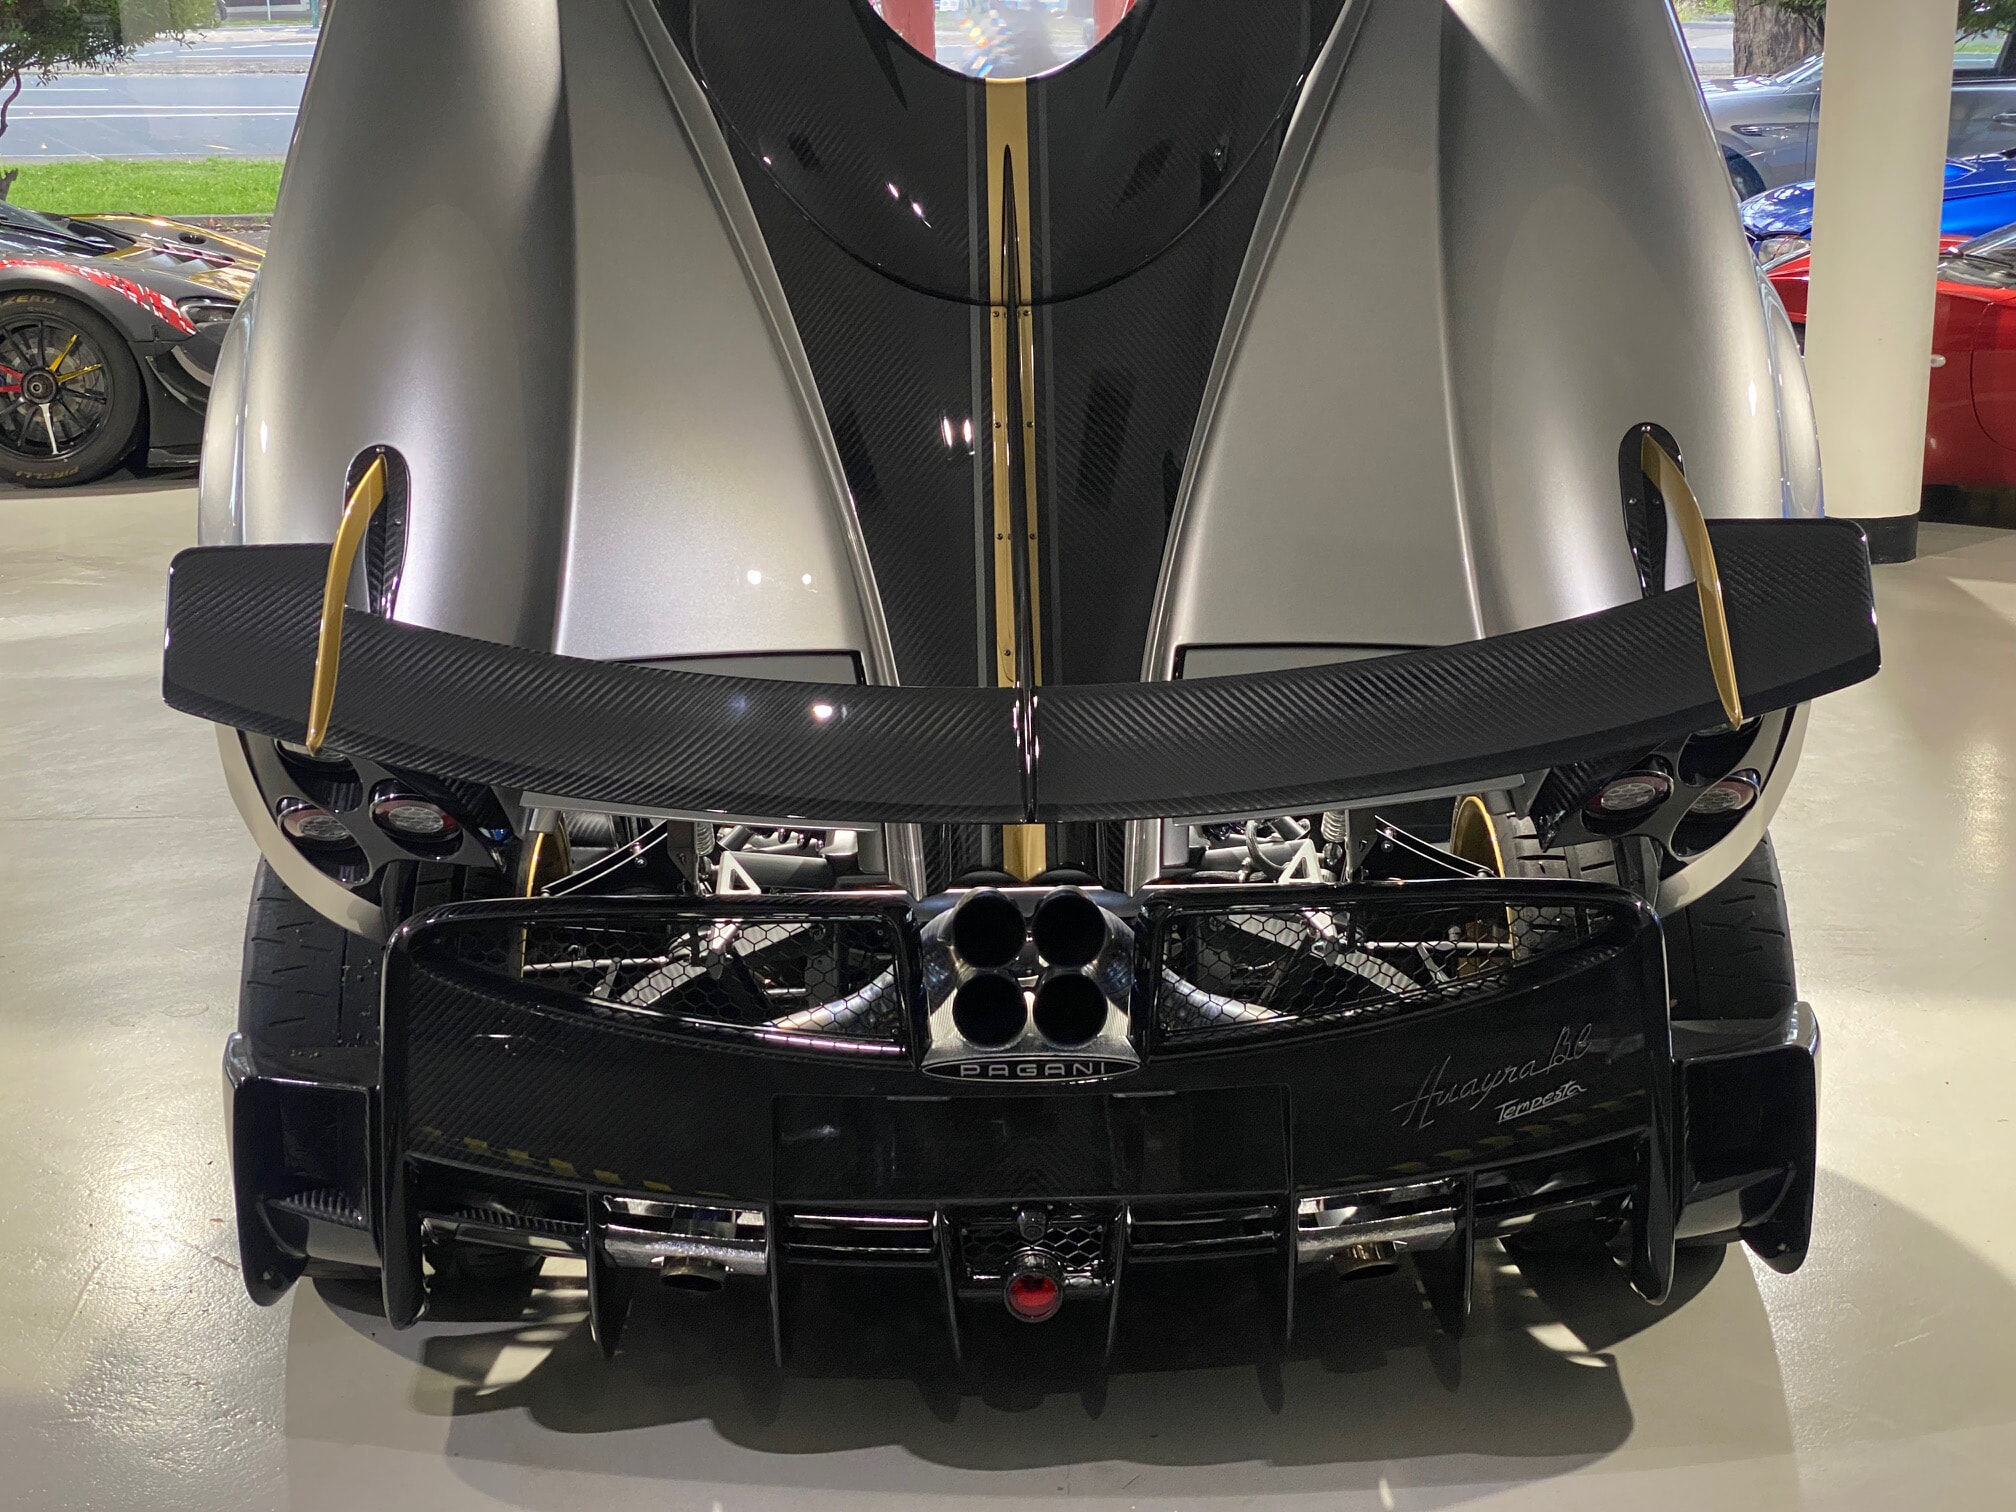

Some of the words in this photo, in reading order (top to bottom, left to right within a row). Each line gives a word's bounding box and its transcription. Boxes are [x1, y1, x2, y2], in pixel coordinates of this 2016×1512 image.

[960, 1062, 1105, 1077] PAGANI
[1392, 1055, 1546, 1129] Huayra
[1494, 1080, 1588, 1122] Tempesta
